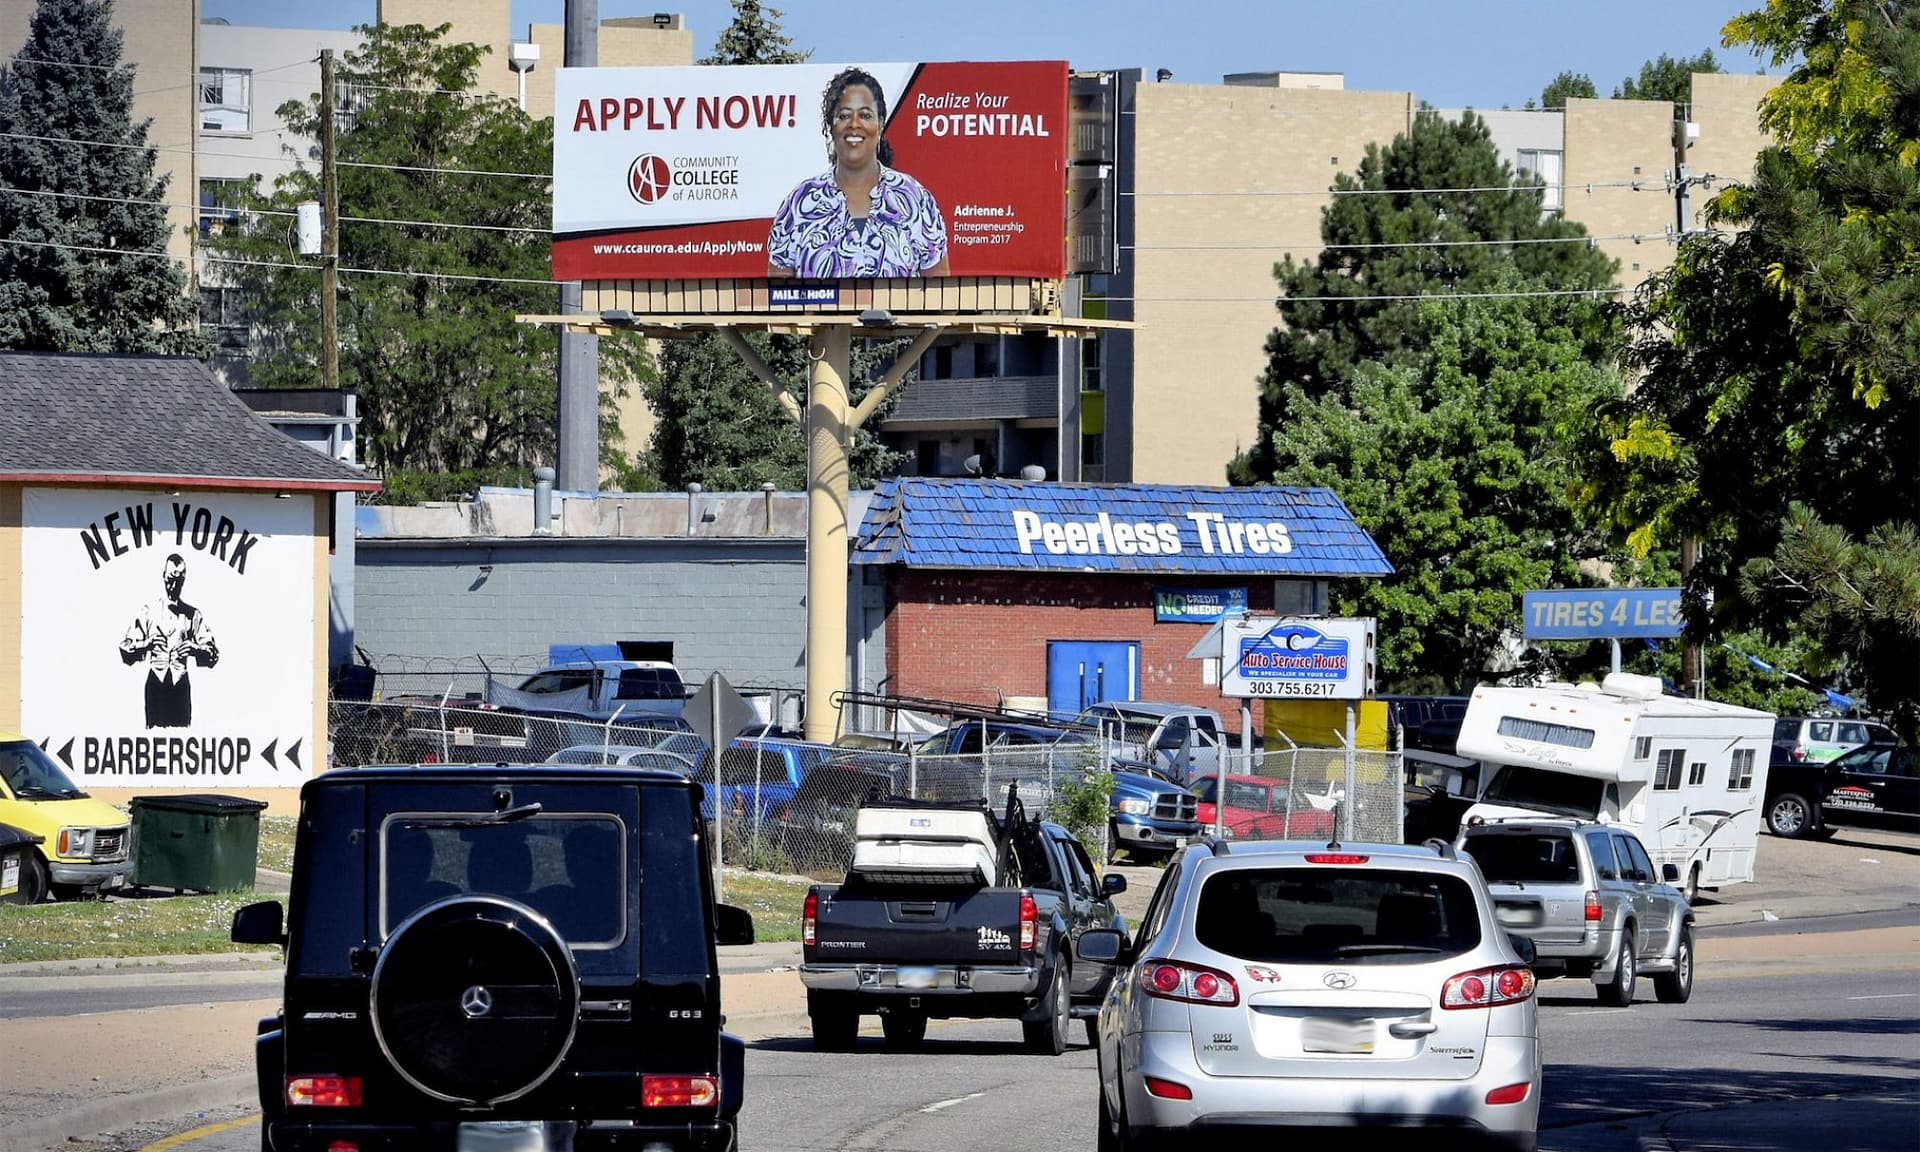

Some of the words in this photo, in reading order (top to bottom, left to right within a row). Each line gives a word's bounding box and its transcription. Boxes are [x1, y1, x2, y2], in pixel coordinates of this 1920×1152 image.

[916, 91, 971, 109] Realize
[975, 92, 1010, 108] Your
[573, 97, 686, 132] APPLY
[696, 95, 797, 130] NOW!
[916, 114, 1050, 137] POTENTIAL
[673, 156, 740, 169] COMMUNITY
[673, 170, 739, 186] COLLEGE
[672, 189, 683, 201] of
[687, 188, 739, 201] AURORA
[954, 205, 1004, 217] Adrienne
[1005, 205, 1015, 217] J.
[953, 221, 1024, 233] Entrepreneurship
[953, 234, 989, 246] Program
[990, 234, 1011, 244] 2017
[593, 241, 764, 256] www.ccaurora.edu/ApplyNow
[772, 289, 800, 300] MILE
[807, 289, 835, 300] HIGH
[80, 502, 153, 570] NEW
[172, 502, 259, 575] YORK
[1013, 510, 1182, 554] Peerless
[1187, 511, 1292, 554] Tires
[1158, 592, 1187, 616] NO
[1186, 594, 1219, 604] CREDIT
[1531, 601, 1605, 627] TIRES
[1610, 598, 1628, 627] 4
[1634, 600, 1682, 626] LES
[1242, 649, 1269, 668] Auto
[1271, 653, 1311, 669] Service
[1313, 654, 1346, 669] House
[1249, 682, 1336, 695] 303.755.6217
[84, 736, 251, 775] BARBERSHOP
[820, 940, 867, 949] FRONTIER
[1203, 1044, 1239, 1052] HYUNDAI
